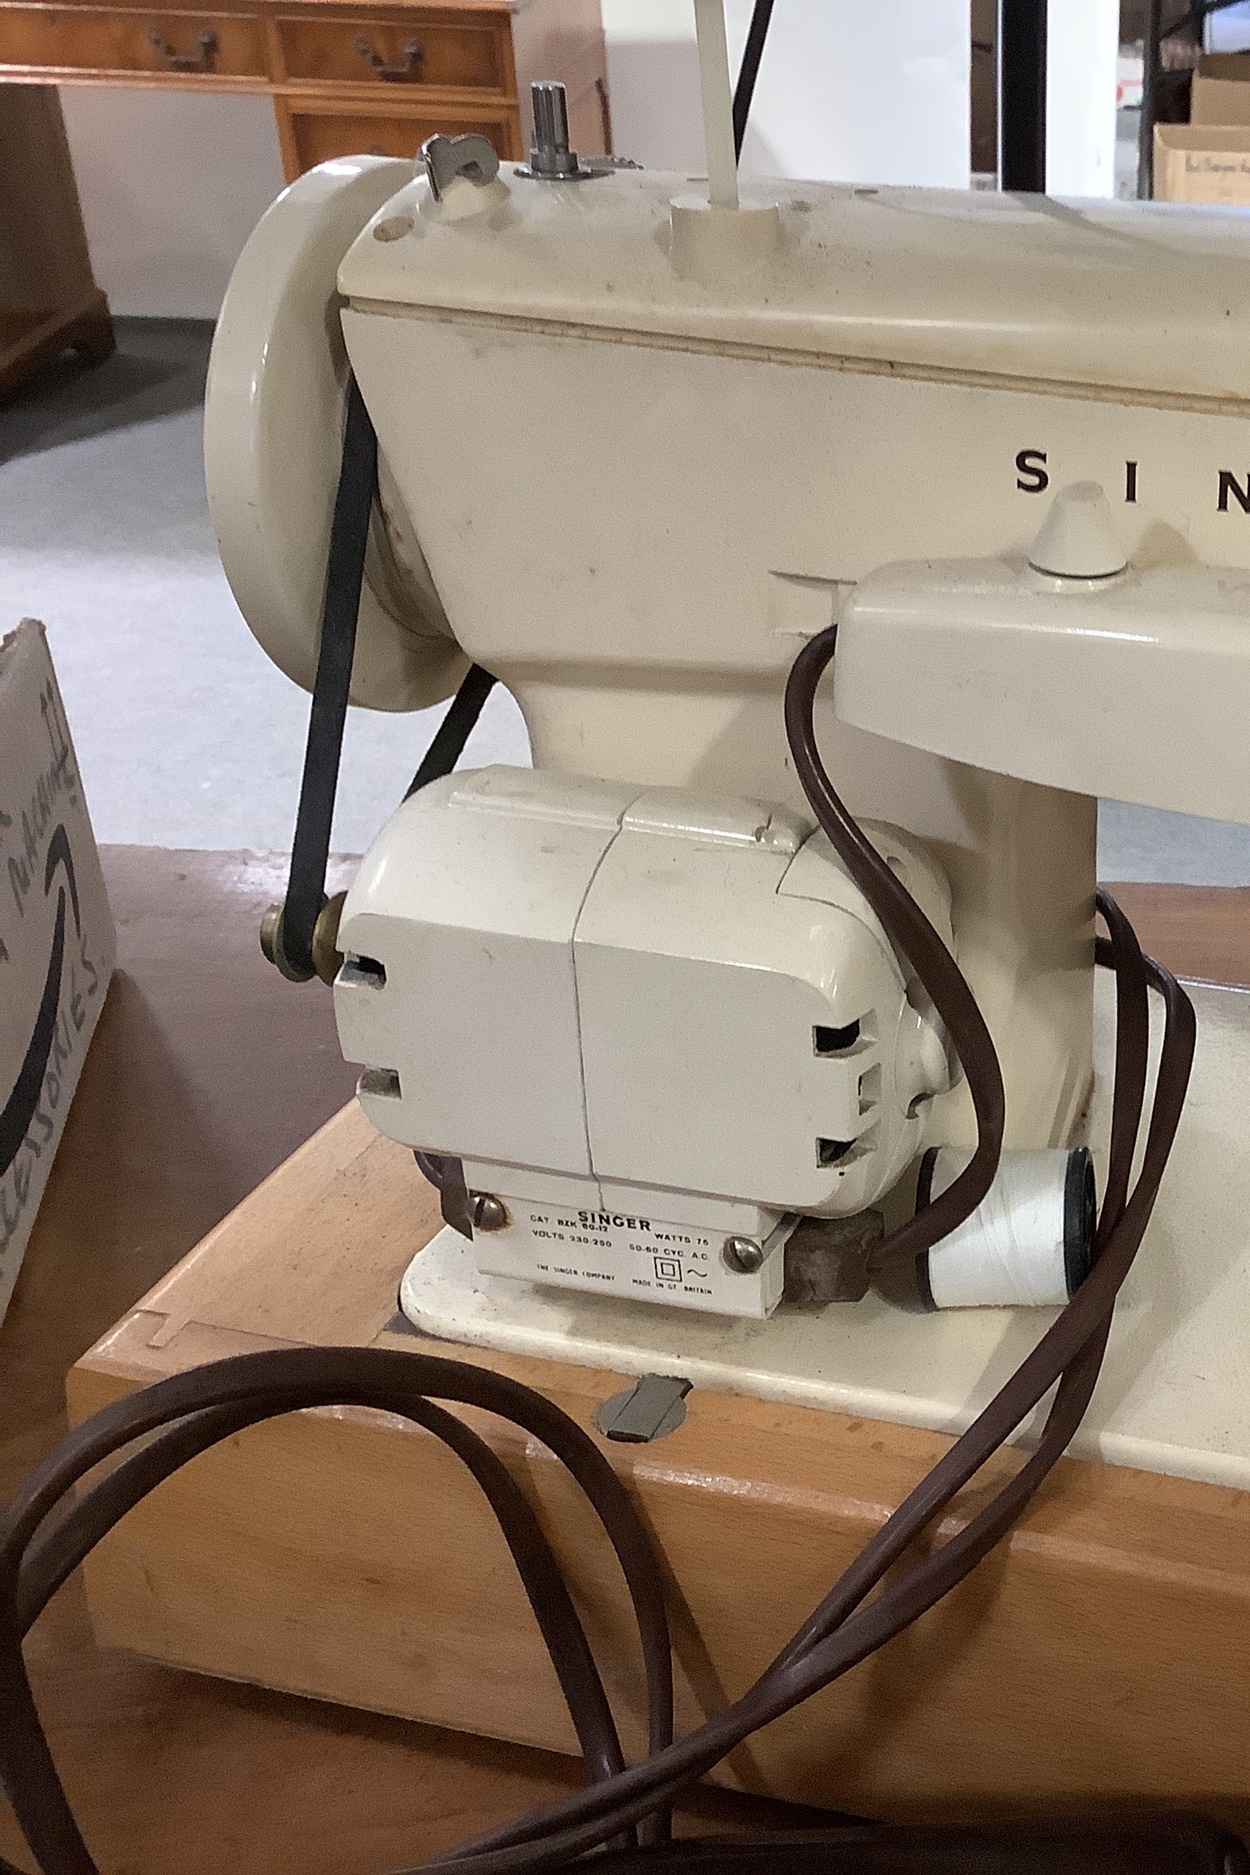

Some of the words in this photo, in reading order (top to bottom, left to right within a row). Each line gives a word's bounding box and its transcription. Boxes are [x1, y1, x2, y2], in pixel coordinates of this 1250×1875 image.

[578, 1211, 651, 1232] SINGER
[532, 1229, 564, 1240] VOLTS
[655, 1233, 691, 1243] WATTS
[537, 1263, 549, 1271] THE
[553, 1267, 578, 1275] SINGER
[582, 1271, 615, 1281] COMPANY
[632, 1279, 651, 1287] MADE
[684, 1285, 713, 1295] BRITAIN
